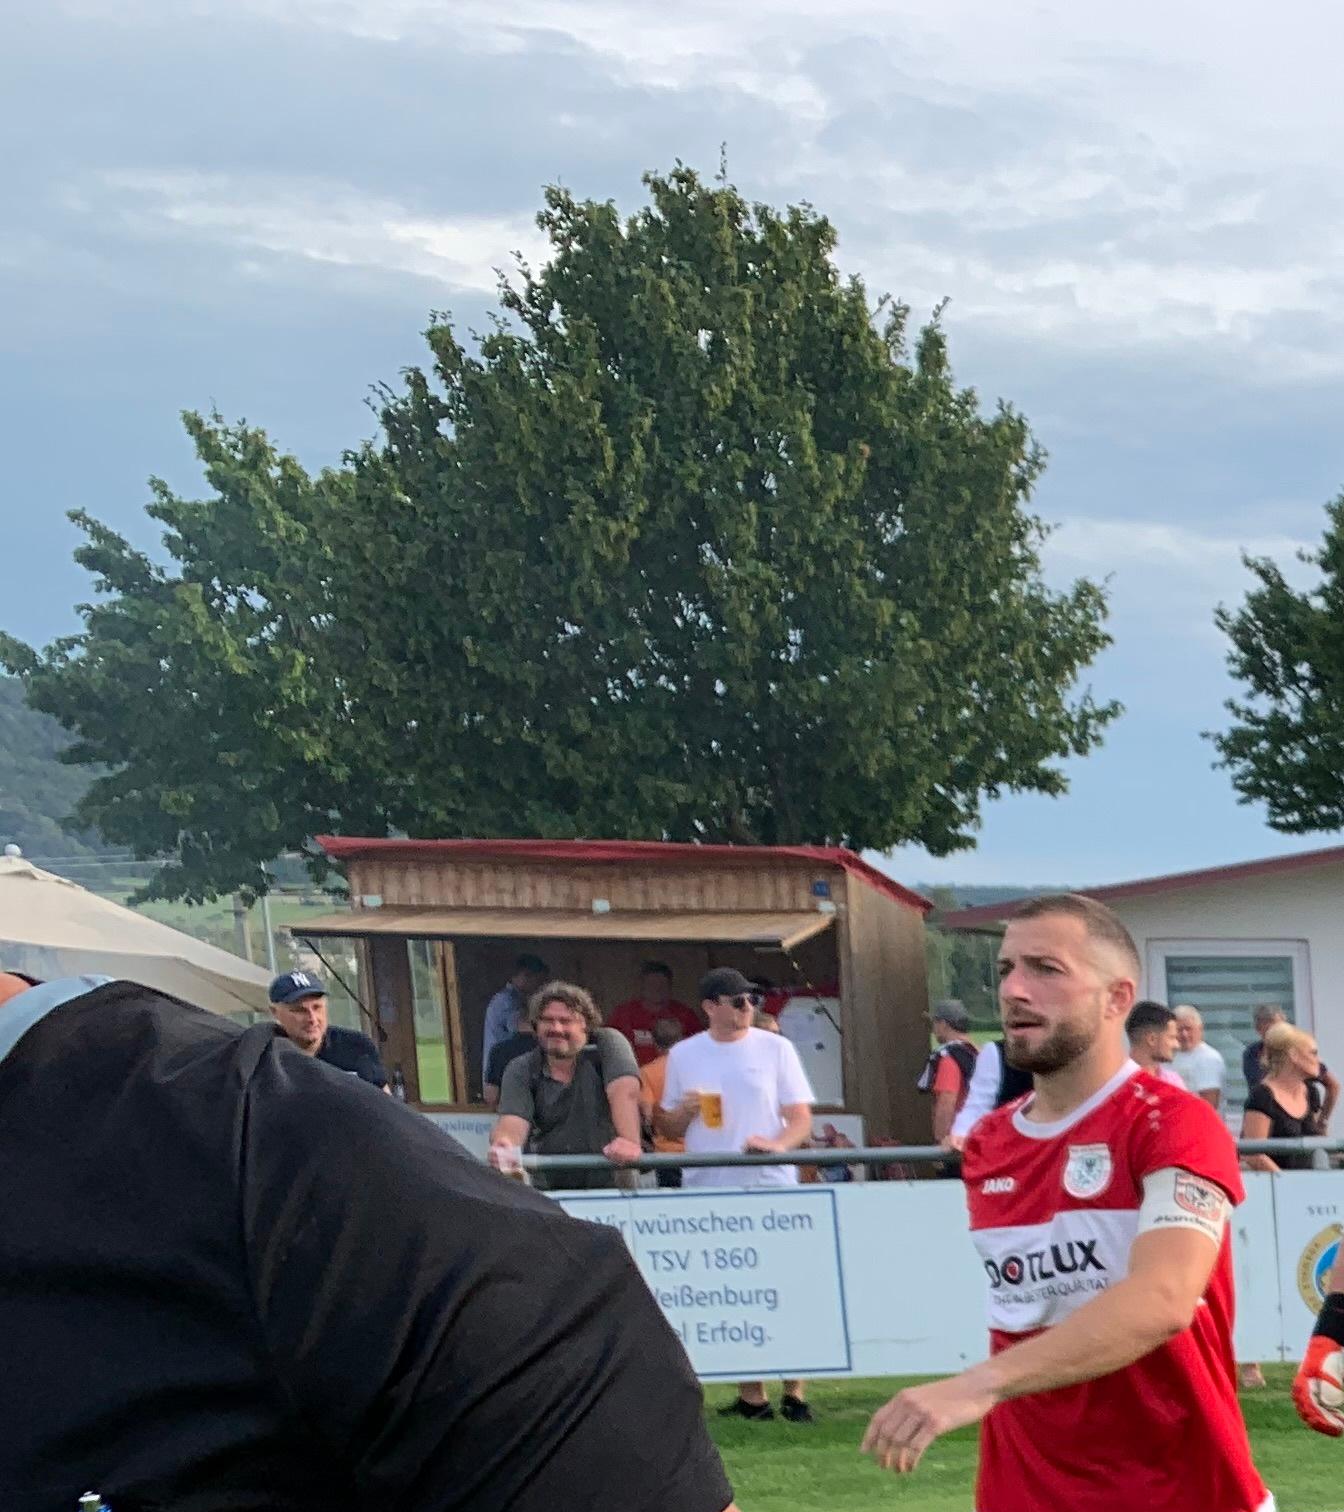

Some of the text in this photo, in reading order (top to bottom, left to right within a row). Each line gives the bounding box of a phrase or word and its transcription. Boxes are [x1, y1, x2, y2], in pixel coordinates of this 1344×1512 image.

[982, 1176, 1016, 1194] JAKO
[634, 1211, 755, 1236] wünschen
[762, 1209, 814, 1231] dem
[647, 1246, 758, 1271] TSV 1860
[984, 1239, 1107, 1289] DOTLUX
[653, 1284, 778, 1310] eißenburg
[696, 1320, 773, 1347] Erfolg.
